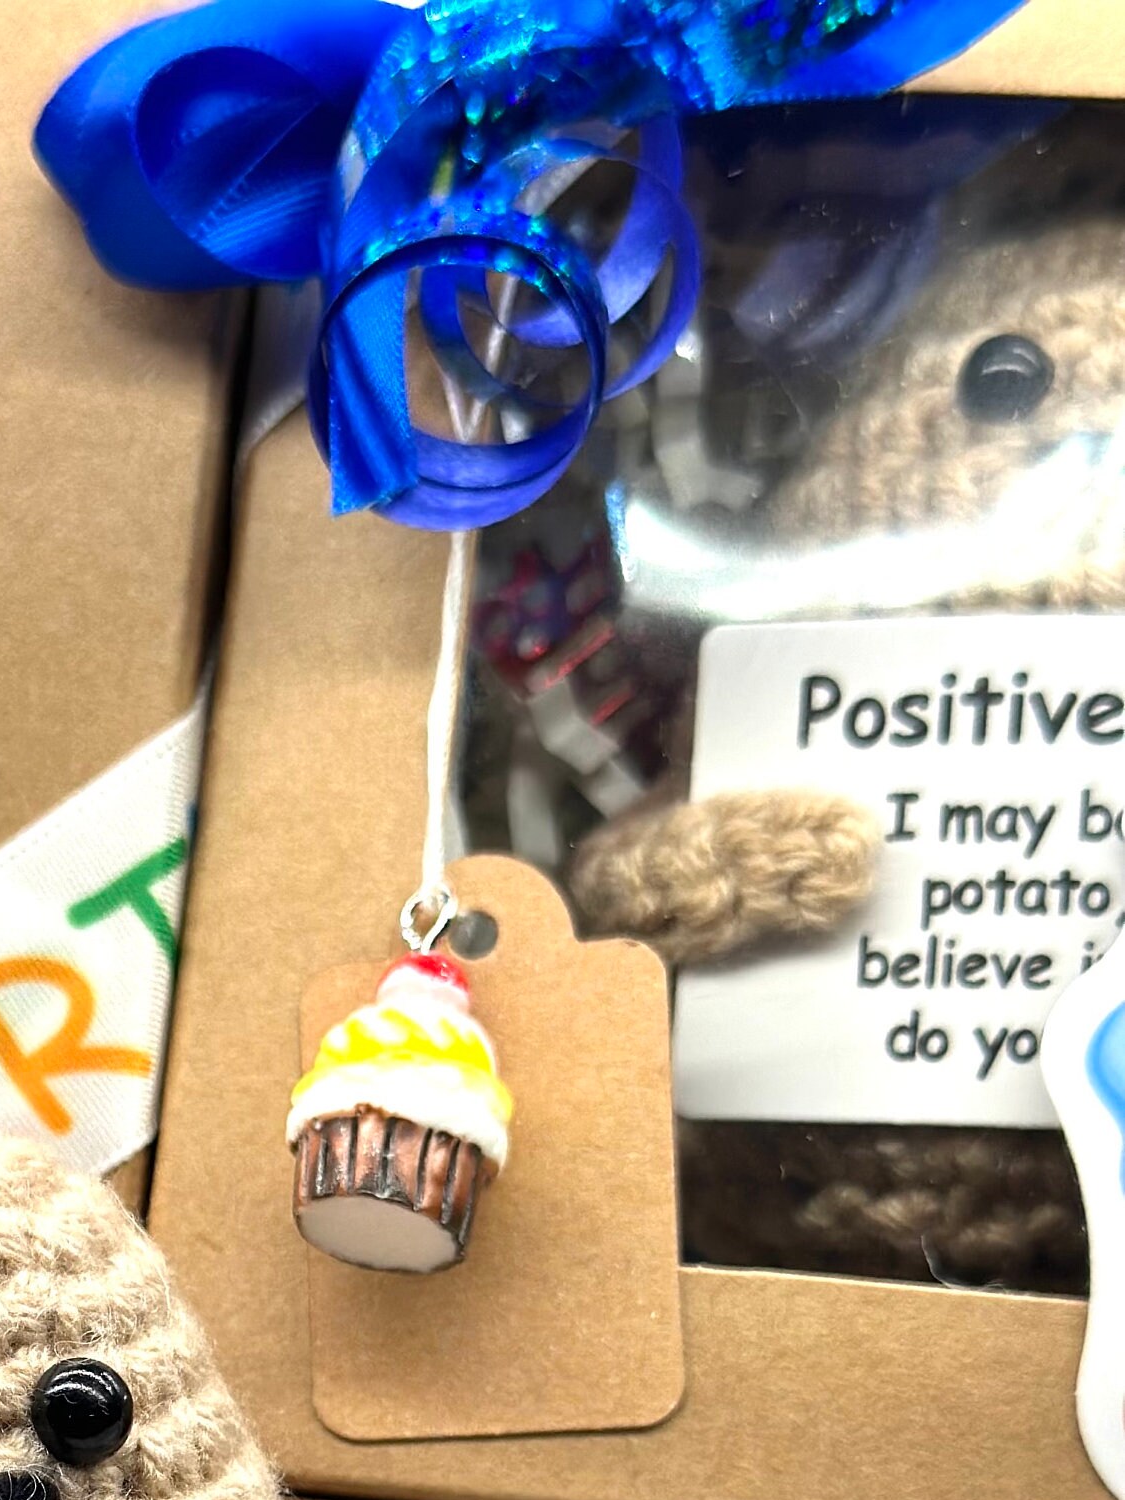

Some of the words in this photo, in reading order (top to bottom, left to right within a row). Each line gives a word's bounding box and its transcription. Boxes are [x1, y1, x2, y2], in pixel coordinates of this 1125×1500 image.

[798, 672, 1124, 748] Positive
[886, 792, 919, 842] I
[940, 804, 1056, 858] may
[858, 933, 1053, 989] believe
[886, 1010, 949, 1062] do
